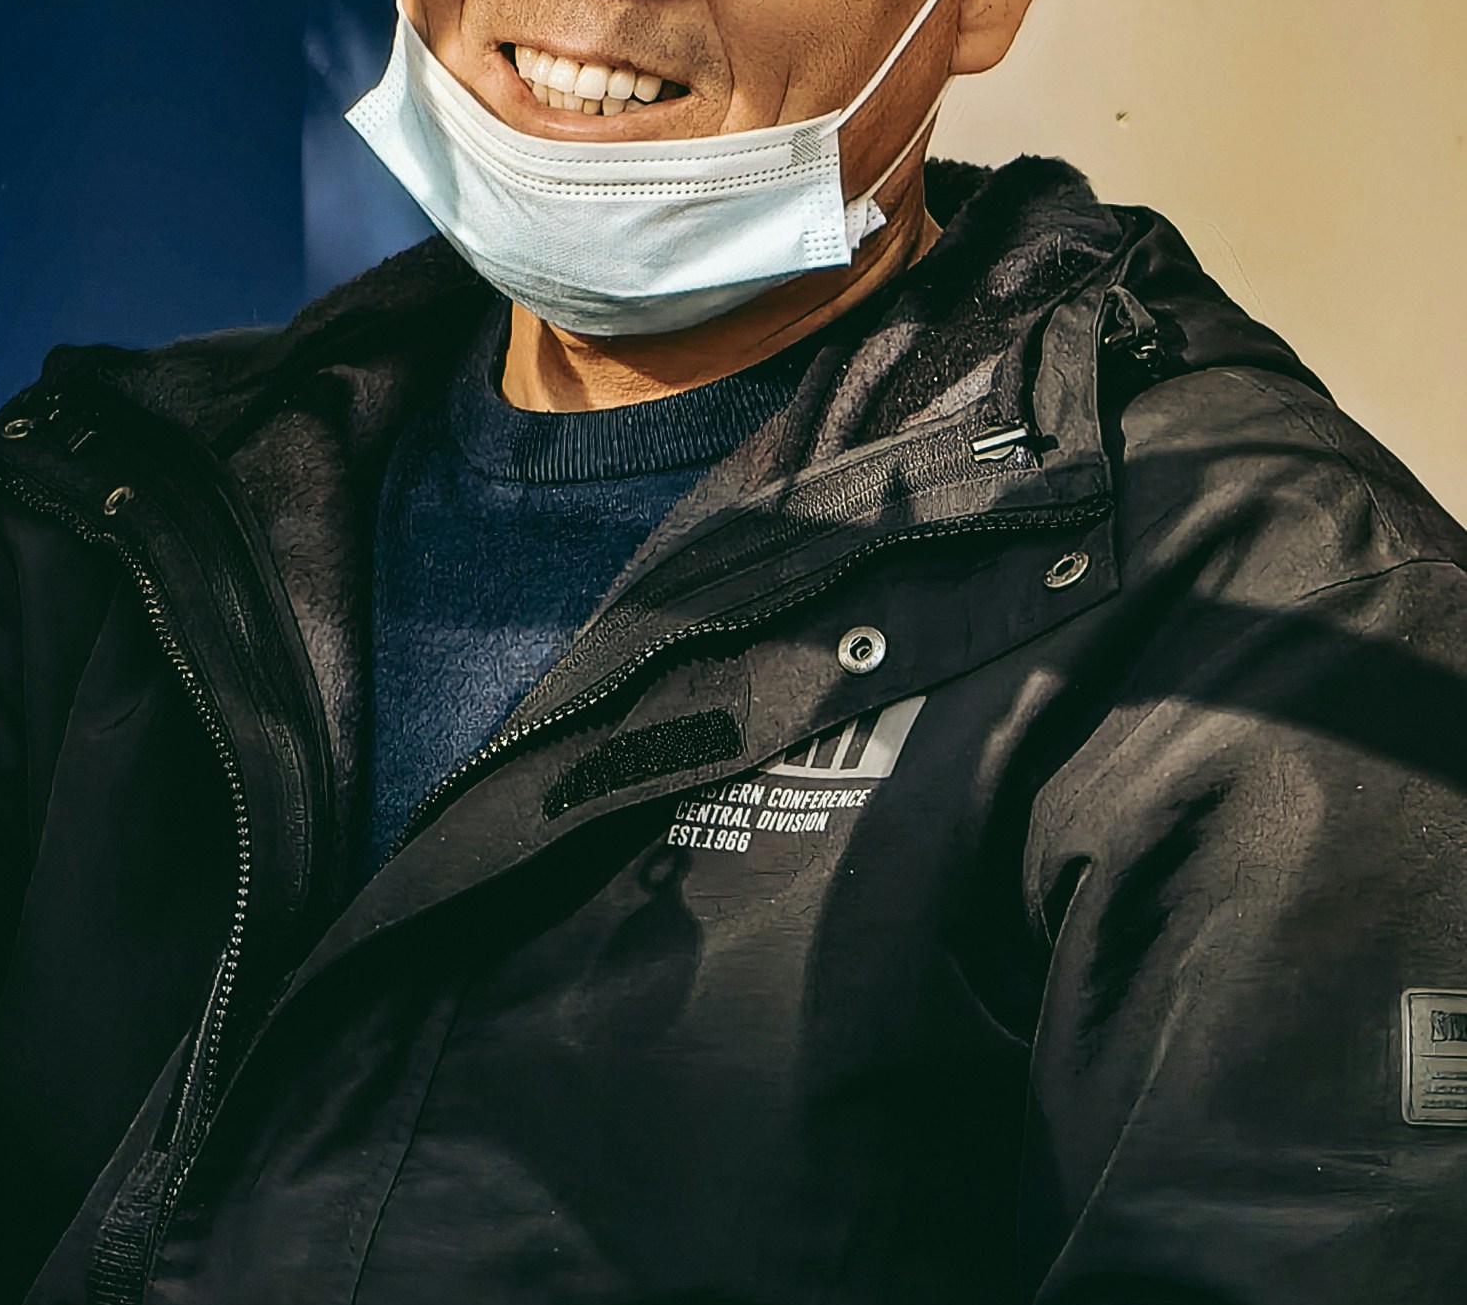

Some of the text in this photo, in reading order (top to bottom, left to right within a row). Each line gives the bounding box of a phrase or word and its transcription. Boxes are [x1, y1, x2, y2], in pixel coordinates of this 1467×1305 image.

[767, 787, 872, 809] CONFERENCE
[675, 800, 830, 833] CENTRAL DIVISION
[667, 824, 752, 853] EST.1966
